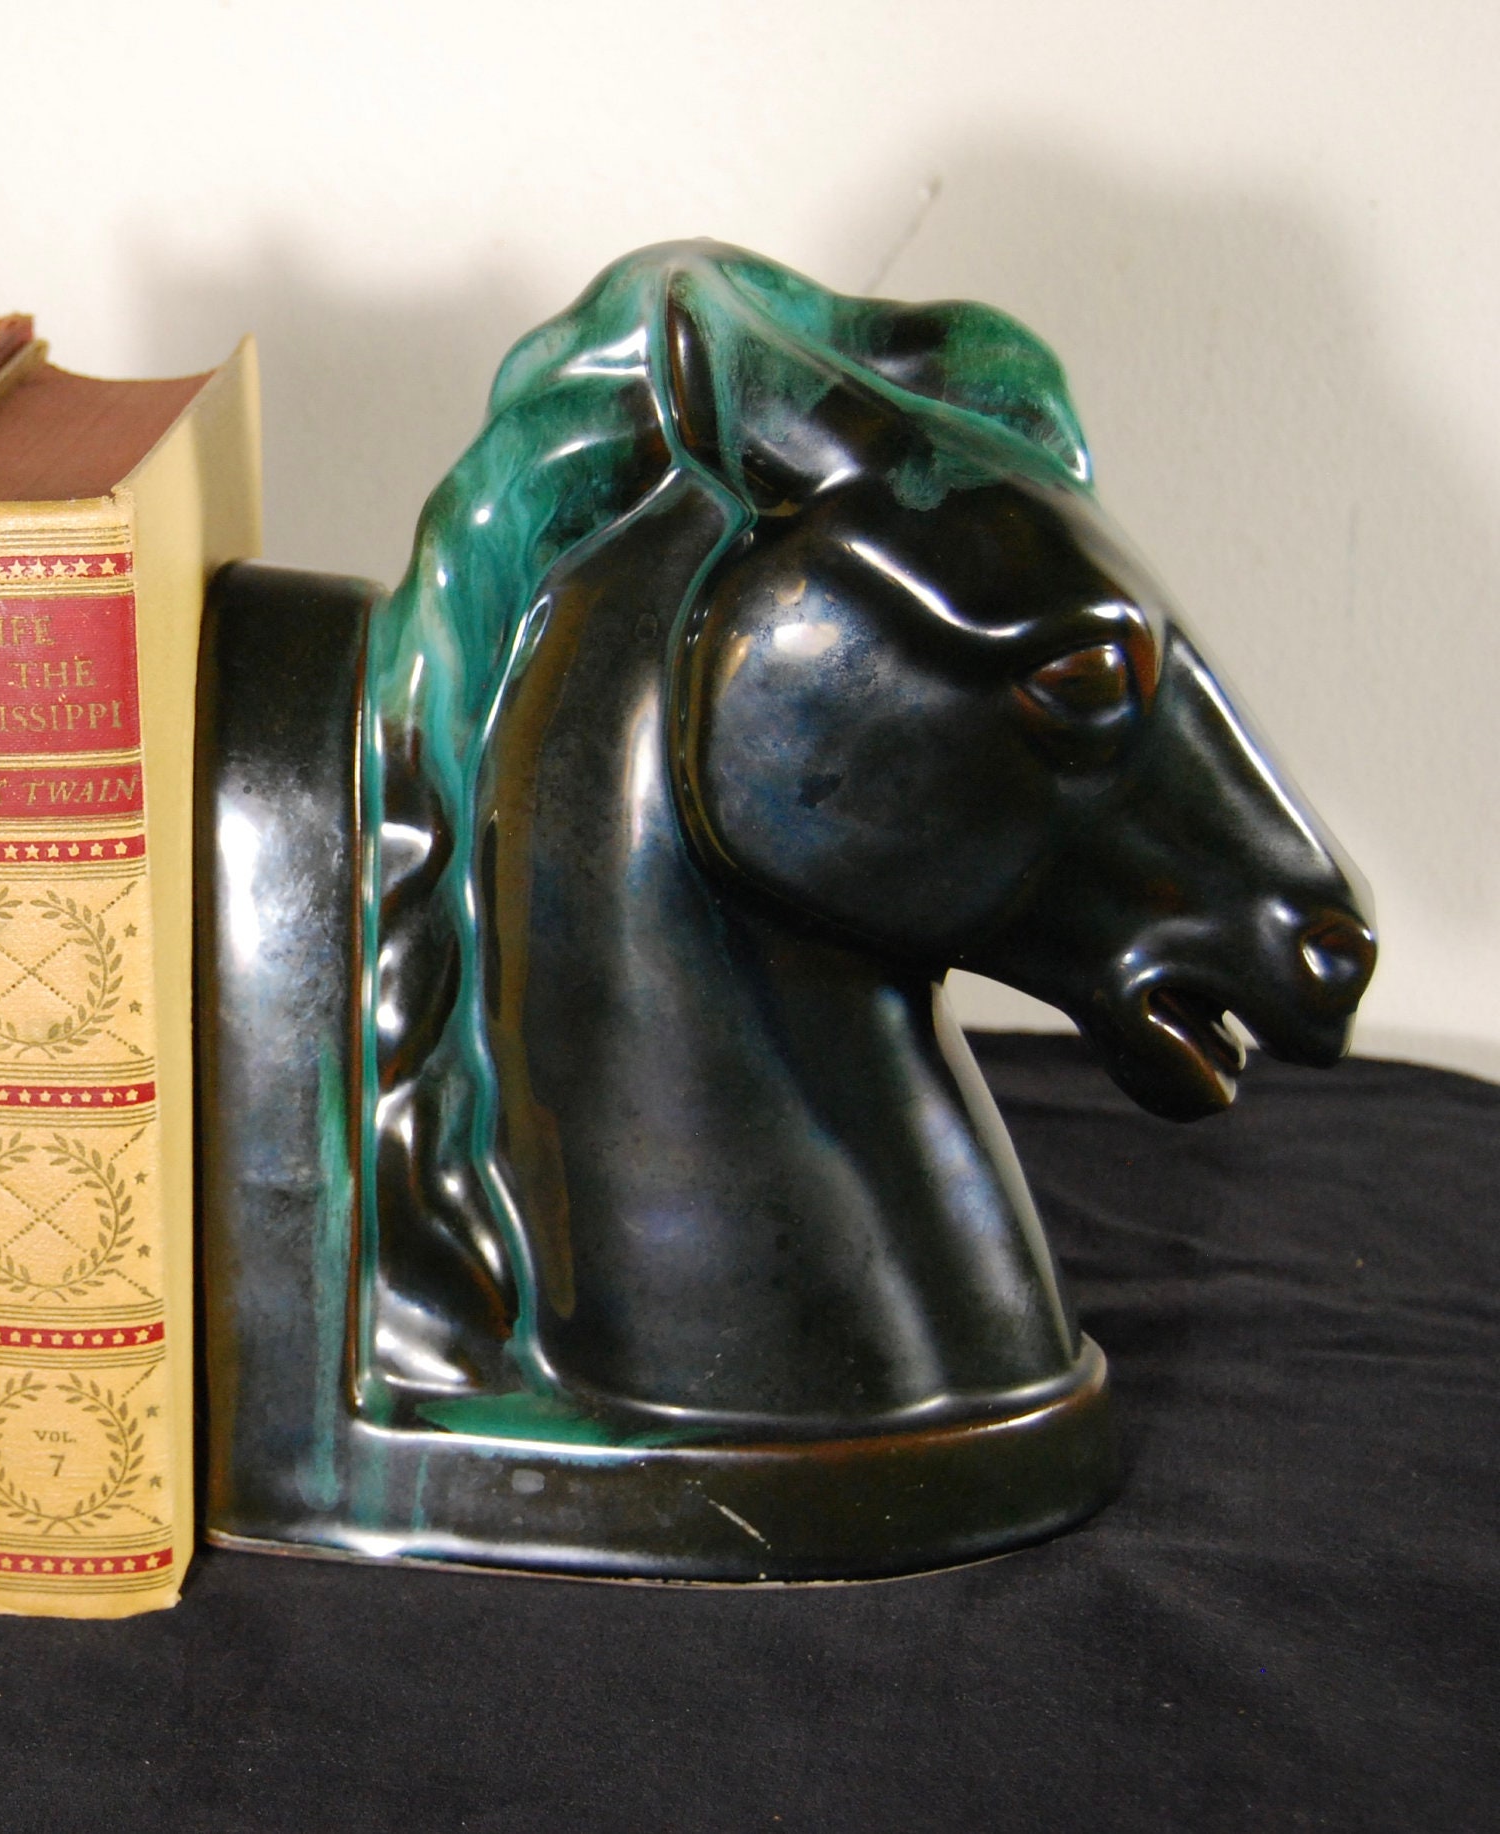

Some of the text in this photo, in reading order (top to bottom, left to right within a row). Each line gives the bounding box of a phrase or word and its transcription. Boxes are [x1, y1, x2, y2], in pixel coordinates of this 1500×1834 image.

[9, 659, 98, 689] THE
[22, 774, 140, 805] TWAIN
[33, 1430, 77, 1443] VOL.
[49, 1454, 66, 1477] 7
